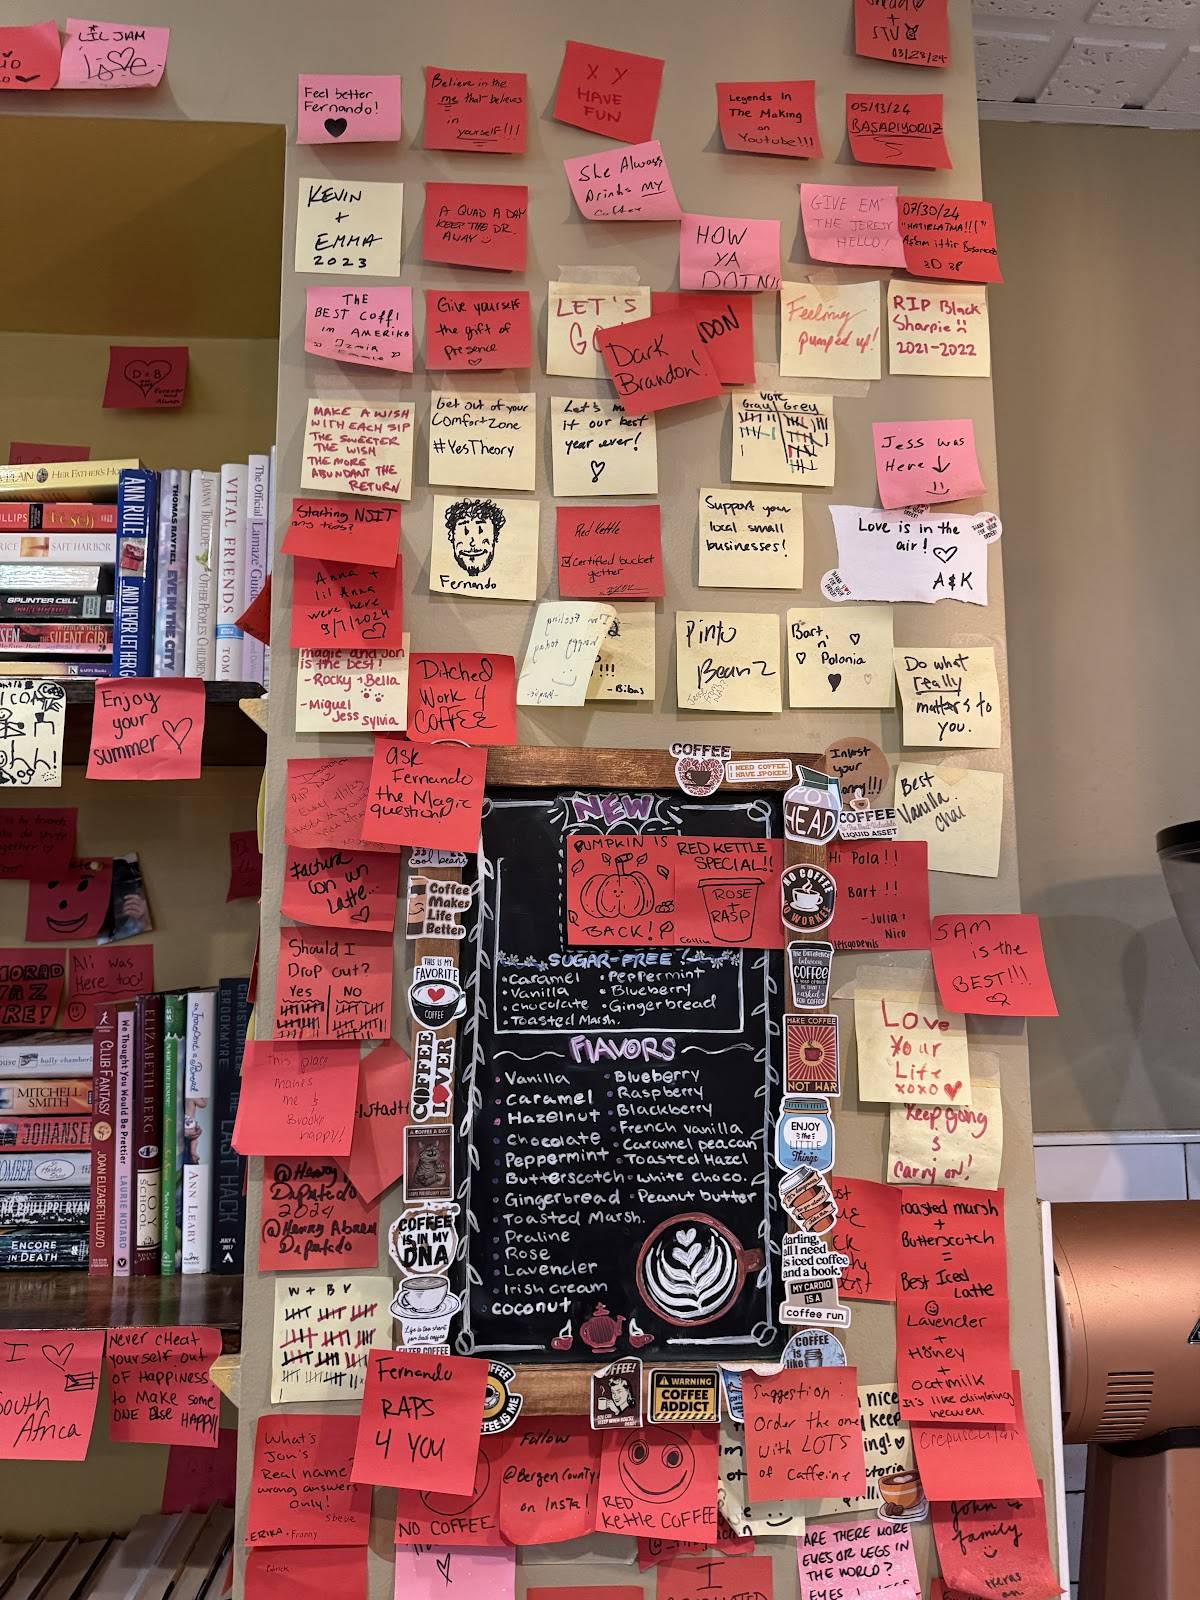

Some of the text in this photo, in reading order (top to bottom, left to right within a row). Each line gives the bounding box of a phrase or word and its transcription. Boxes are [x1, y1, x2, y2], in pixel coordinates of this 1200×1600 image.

[304, 87, 373, 99] Feel better
[577, 88, 622, 106] HAVE
[304, 102, 378, 115] Fernando!
[584, 106, 621, 122] FUN
[729, 109, 802, 123] The Making
[308, 186, 362, 207] KEVIN
[315, 234, 382, 251] EMMA
[697, 226, 748, 245] HOW
[314, 256, 366, 268] 2023
[714, 252, 740, 269] YA
[437, 298, 520, 318] Give yourself
[893, 296, 981, 316] RIP Black
[436, 322, 511, 339] the gift of
[893, 315, 951, 334] Sharpie
[444, 344, 497, 360] presence
[606, 335, 668, 368] Dark
[896, 342, 977, 357] 2021-2022
[615, 350, 708, 396] Brandon!
[314, 407, 410, 419] MAKE A WISH
[437, 398, 528, 414] Get out of your
[742, 402, 819, 415] Gray Grey
[433, 439, 514, 457] #YesTheory
[882, 436, 965, 450] Jess was
[886, 461, 924, 472] Here
[123, 477, 146, 534] ANN RULE
[710, 521, 784, 534] local small
[859, 518, 890, 534] Love
[899, 521, 910, 534] is
[920, 523, 932, 534] in
[938, 523, 960, 535] the
[223, 477, 238, 614] VITAL FRIENDS
[706, 539, 788, 557] businesses!
[897, 539, 928, 553] air!
[439, 575, 496, 589] Fernando
[121, 607, 138, 634] NEVER
[50, 631, 108, 644] SILENT GIRL
[120, 652, 137, 668] HER
[221, 648, 230, 673] TOM
[821, 652, 866, 665] Polonia
[905, 654, 969, 672] Do what
[418, 659, 492, 682] Ditched
[913, 675, 961, 692] really
[102, 690, 160, 714] Enjoy
[916, 693, 992, 714] matters to
[113, 713, 149, 739] your
[938, 720, 972, 741] you.
[94, 734, 159, 765] summer
[672, 743, 730, 758] COFFEE
[392, 768, 472, 785] Fernando
[573, 794, 654, 825] NEW
[785, 804, 833, 836] HEAD
[677, 842, 767, 856] RED KETTLE
[429, 883, 469, 895] Coffee
[712, 889, 752, 899] ROSE
[429, 896, 469, 908] Makes
[427, 908, 452, 920] Life
[711, 911, 750, 924] RASP
[426, 922, 464, 935] Better
[935, 920, 991, 940] SAM
[289, 939, 356, 957] Should I
[971, 942, 1027, 959] is the
[424, 958, 435, 966] THIS
[288, 963, 369, 978] Drop out?
[416, 967, 458, 981] FAVORITE
[953, 967, 1031, 992] BEST!!!
[290, 987, 312, 997] Yes
[425, 1009, 444, 1019] COFFEE
[609, 996, 716, 1016] Gingerbread
[99, 1040, 113, 1115] CLUB FANTASY
[505, 1071, 570, 1084] Vanilla
[614, 1070, 700, 1083] Blueberry
[17, 1087, 82, 1098] MITCHELL
[120, 1020, 130, 1164] We Thought You Would Be Prettier
[617, 1086, 704, 1100] Raspberry
[788, 1082, 838, 1091] NOT WAR
[28, 1099, 69, 1107] SMITH
[616, 1104, 712, 1117] Blackberry
[508, 1110, 600, 1124] Hazelnut
[620, 1121, 676, 1134] French
[791, 1122, 820, 1132] ENJOY
[506, 1170, 624, 1184] Butterscotch
[505, 1190, 620, 1210] Gingerbread
[638, 1190, 756, 1203] Peanut butter
[119, 1176, 128, 1249] LAURIE NOTARO
[187, 1172, 198, 1244] ANN LEARY
[400, 1215, 452, 1231] COFFEE
[418, 1232, 449, 1244] IN MY
[505, 1230, 570, 1244] Praline
[11, 1241, 57, 1250] ENCORE
[505, 1247, 550, 1260] Rose
[21, 1252, 57, 1262] DEATH
[402, 1245, 448, 1268] DNA
[792, 1255, 848, 1265] iced coffee
[504, 1261, 598, 1276] Lavender
[901, 1269, 969, 1290] Best Iced
[492, 1298, 572, 1314] coconut
[787, 1309, 822, 1318] coffee
[376, 1357, 452, 1381] Fernando
[662, 1390, 708, 1399] COFFEE
[383, 1398, 435, 1419] RAPS
[661, 1402, 709, 1411] ADDICT
[376, 1430, 444, 1461] 4 YOU
[758, 1435, 850, 1458] with LOTS
[603, 1497, 633, 1510] RED
[399, 1516, 496, 1537] NO COFFEE
[803, 1523, 908, 1547] ARE THERE MORE
